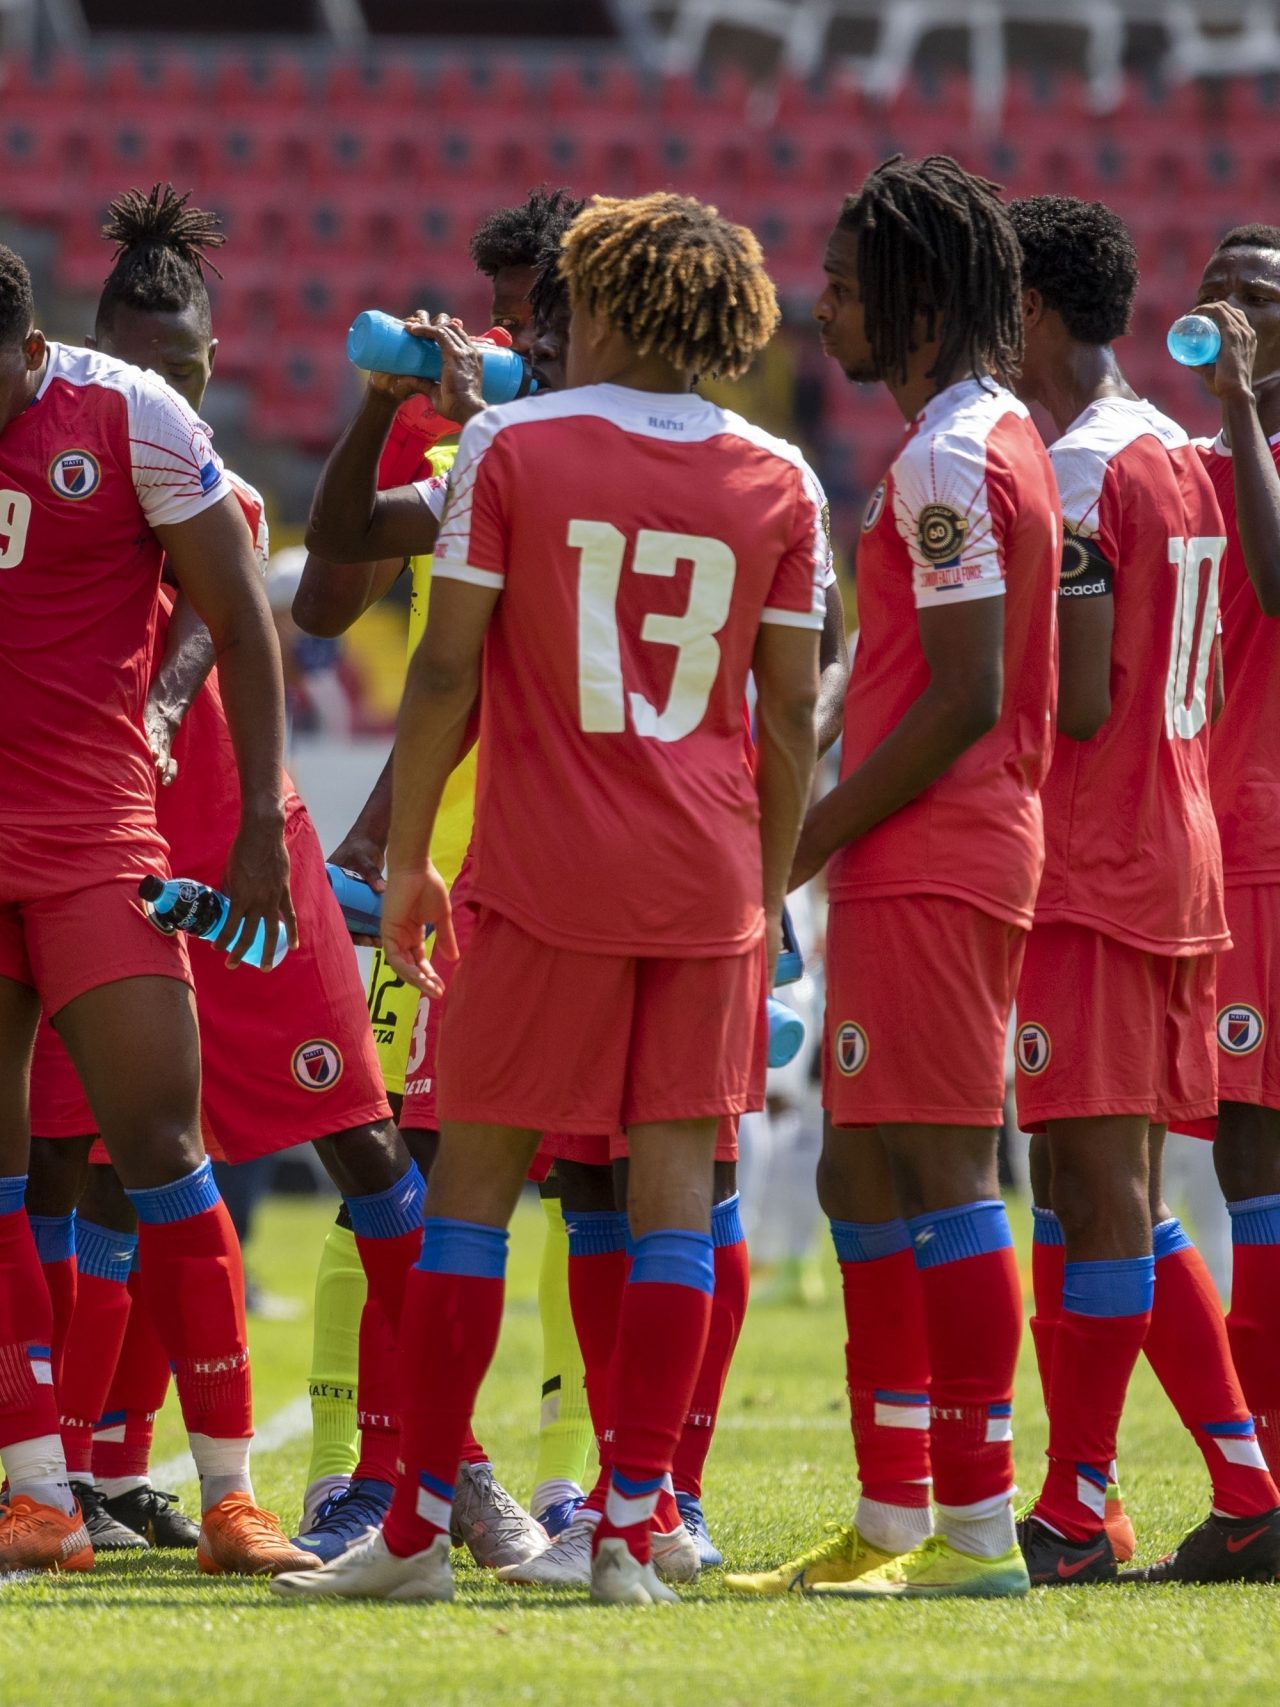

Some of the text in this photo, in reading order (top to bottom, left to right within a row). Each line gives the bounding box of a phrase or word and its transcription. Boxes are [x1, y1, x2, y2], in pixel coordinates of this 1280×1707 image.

[567, 519, 736, 743] 13
[1057, 579, 1106, 596] ncacaf
[1165, 536, 1228, 740] 10
